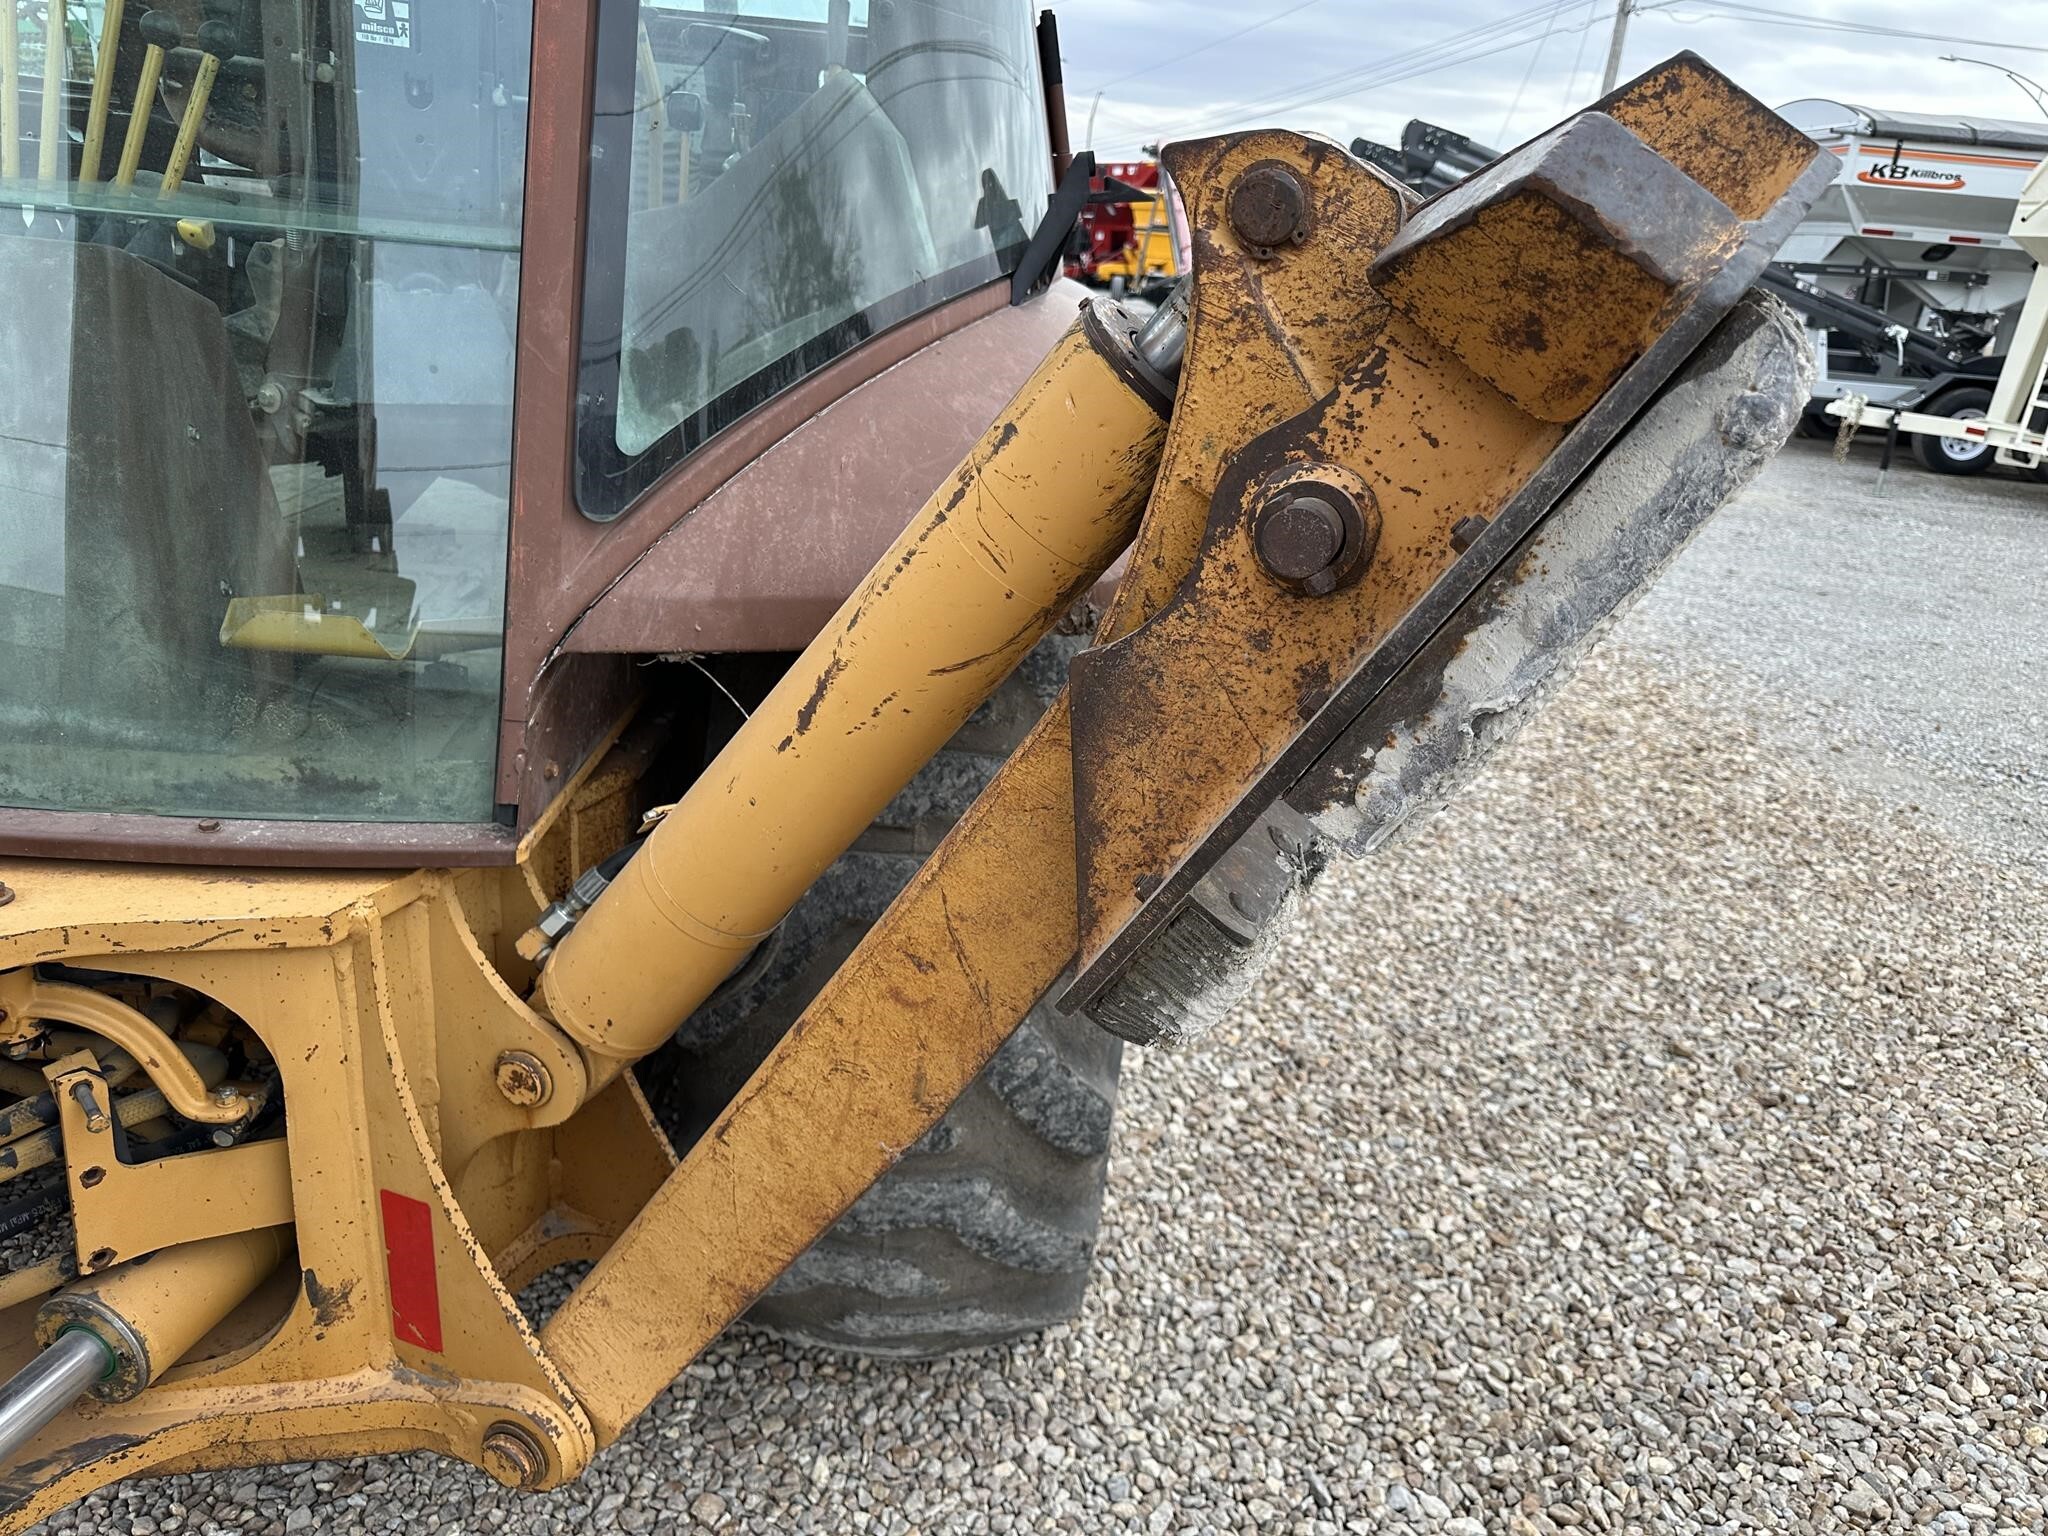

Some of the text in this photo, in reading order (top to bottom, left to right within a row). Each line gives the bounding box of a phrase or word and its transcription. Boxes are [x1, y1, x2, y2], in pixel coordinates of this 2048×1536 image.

[361, 22, 394, 34] milsco
[1869, 163, 1963, 181] KB Killbros
